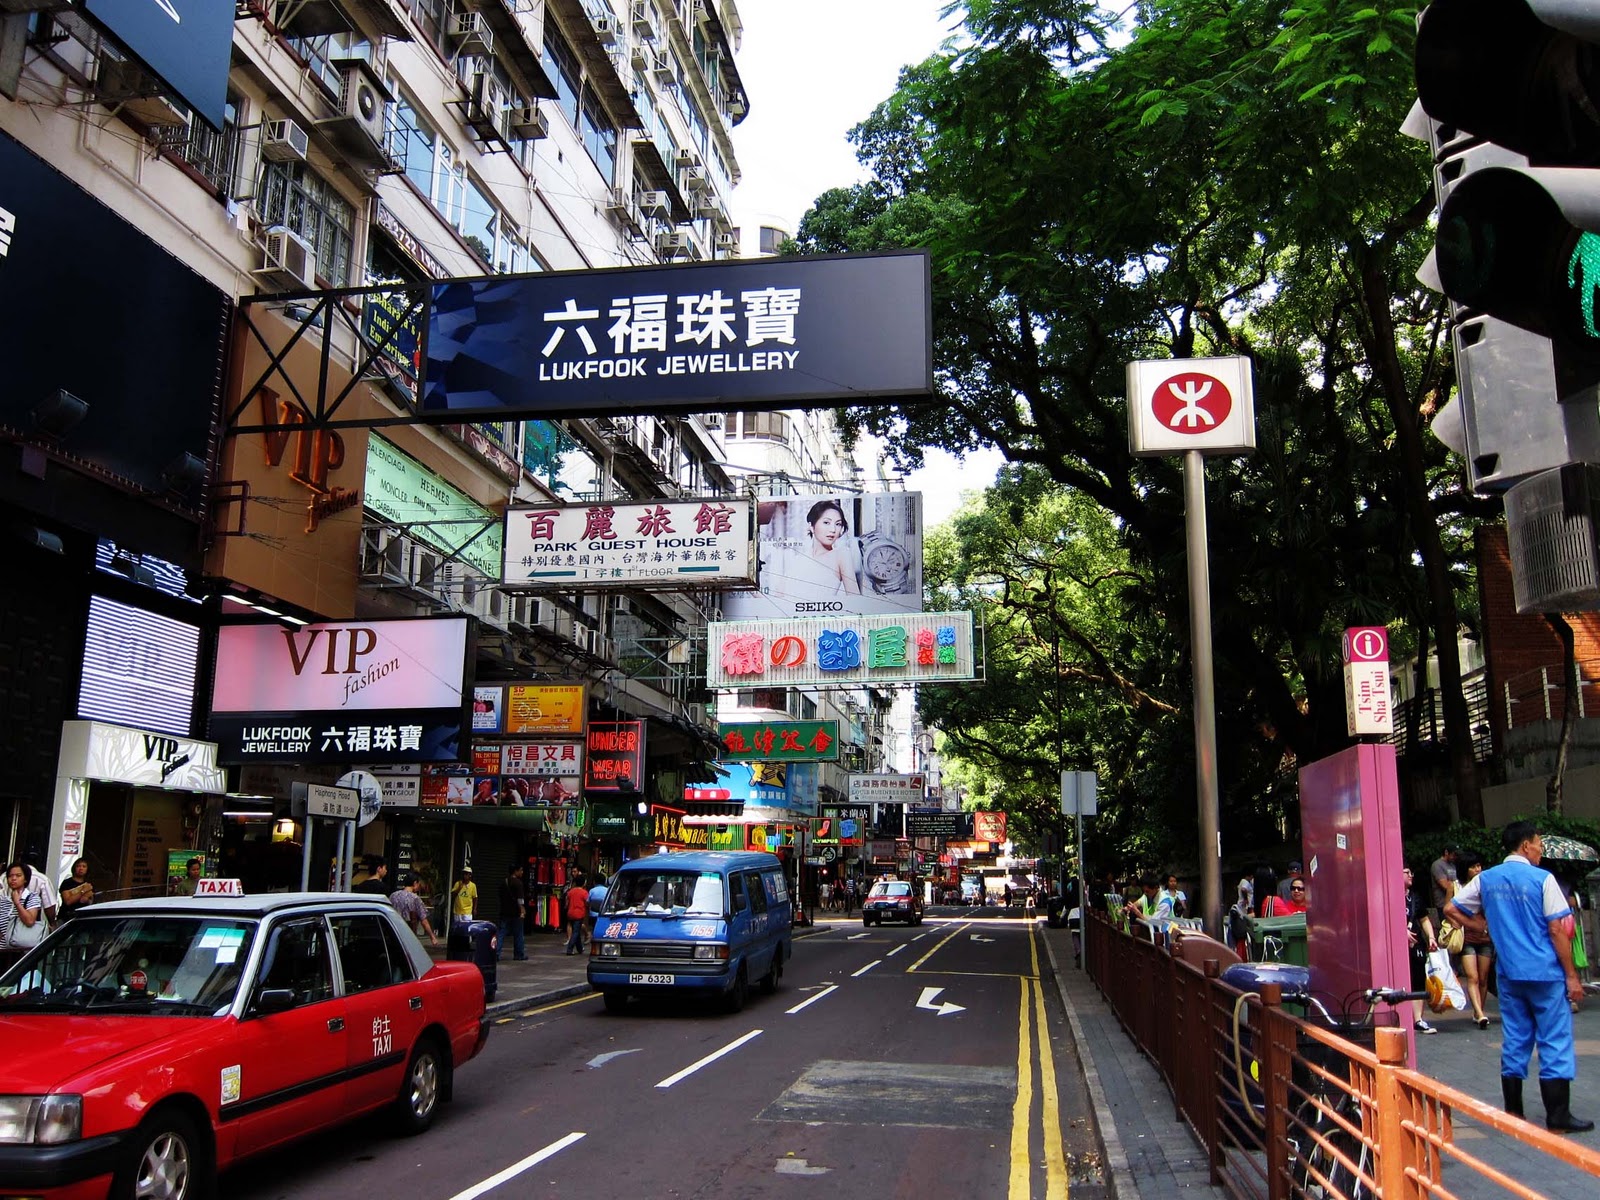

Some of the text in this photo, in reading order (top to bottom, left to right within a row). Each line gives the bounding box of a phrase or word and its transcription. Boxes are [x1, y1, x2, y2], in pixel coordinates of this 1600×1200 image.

[393, 222, 418, 256] 2722
[541, 287, 801, 357] 六福珠寶
[539, 350, 799, 381] LUKFOOK JEWELLERY
[260, 385, 346, 494] VIP
[381, 479, 408, 504] MONCLER
[525, 502, 736, 541] 百麗旅館
[487, 535, 499, 552] D&G
[534, 537, 717, 552] PARK GUEST HOUSE
[468, 552, 495, 577] CHANEL
[639, 567, 674, 577] FLOOR
[795, 601, 843, 612] SEIKO
[281, 628, 377, 675] VIP
[342, 657, 400, 705] fashion
[1358, 681, 1372, 714] Tsim
[1371, 671, 1387, 723] Sha Tsui
[242, 727, 312, 740] LUKFOOK
[321, 725, 422, 752] 六福珠寶
[590, 731, 636, 751] UNDER
[143, 734, 179, 762] VIP
[242, 742, 311, 753] JEWELLERY
[508, 745, 576, 761] 恒昌文具
[593, 760, 632, 780] WEAR
[315, 788, 351, 800] Haiphong Road
[380, 781, 416, 789] 威集團
[323, 802, 341, 815] 海防道
[682, 828, 733, 844] Nikon
[200, 881, 233, 893] TAXI
[690, 925, 716, 937] 155
[631, 975, 672, 983] HP 6323
[372, 1014, 391, 1036] 的士
[372, 1034, 391, 1057] TAXI
